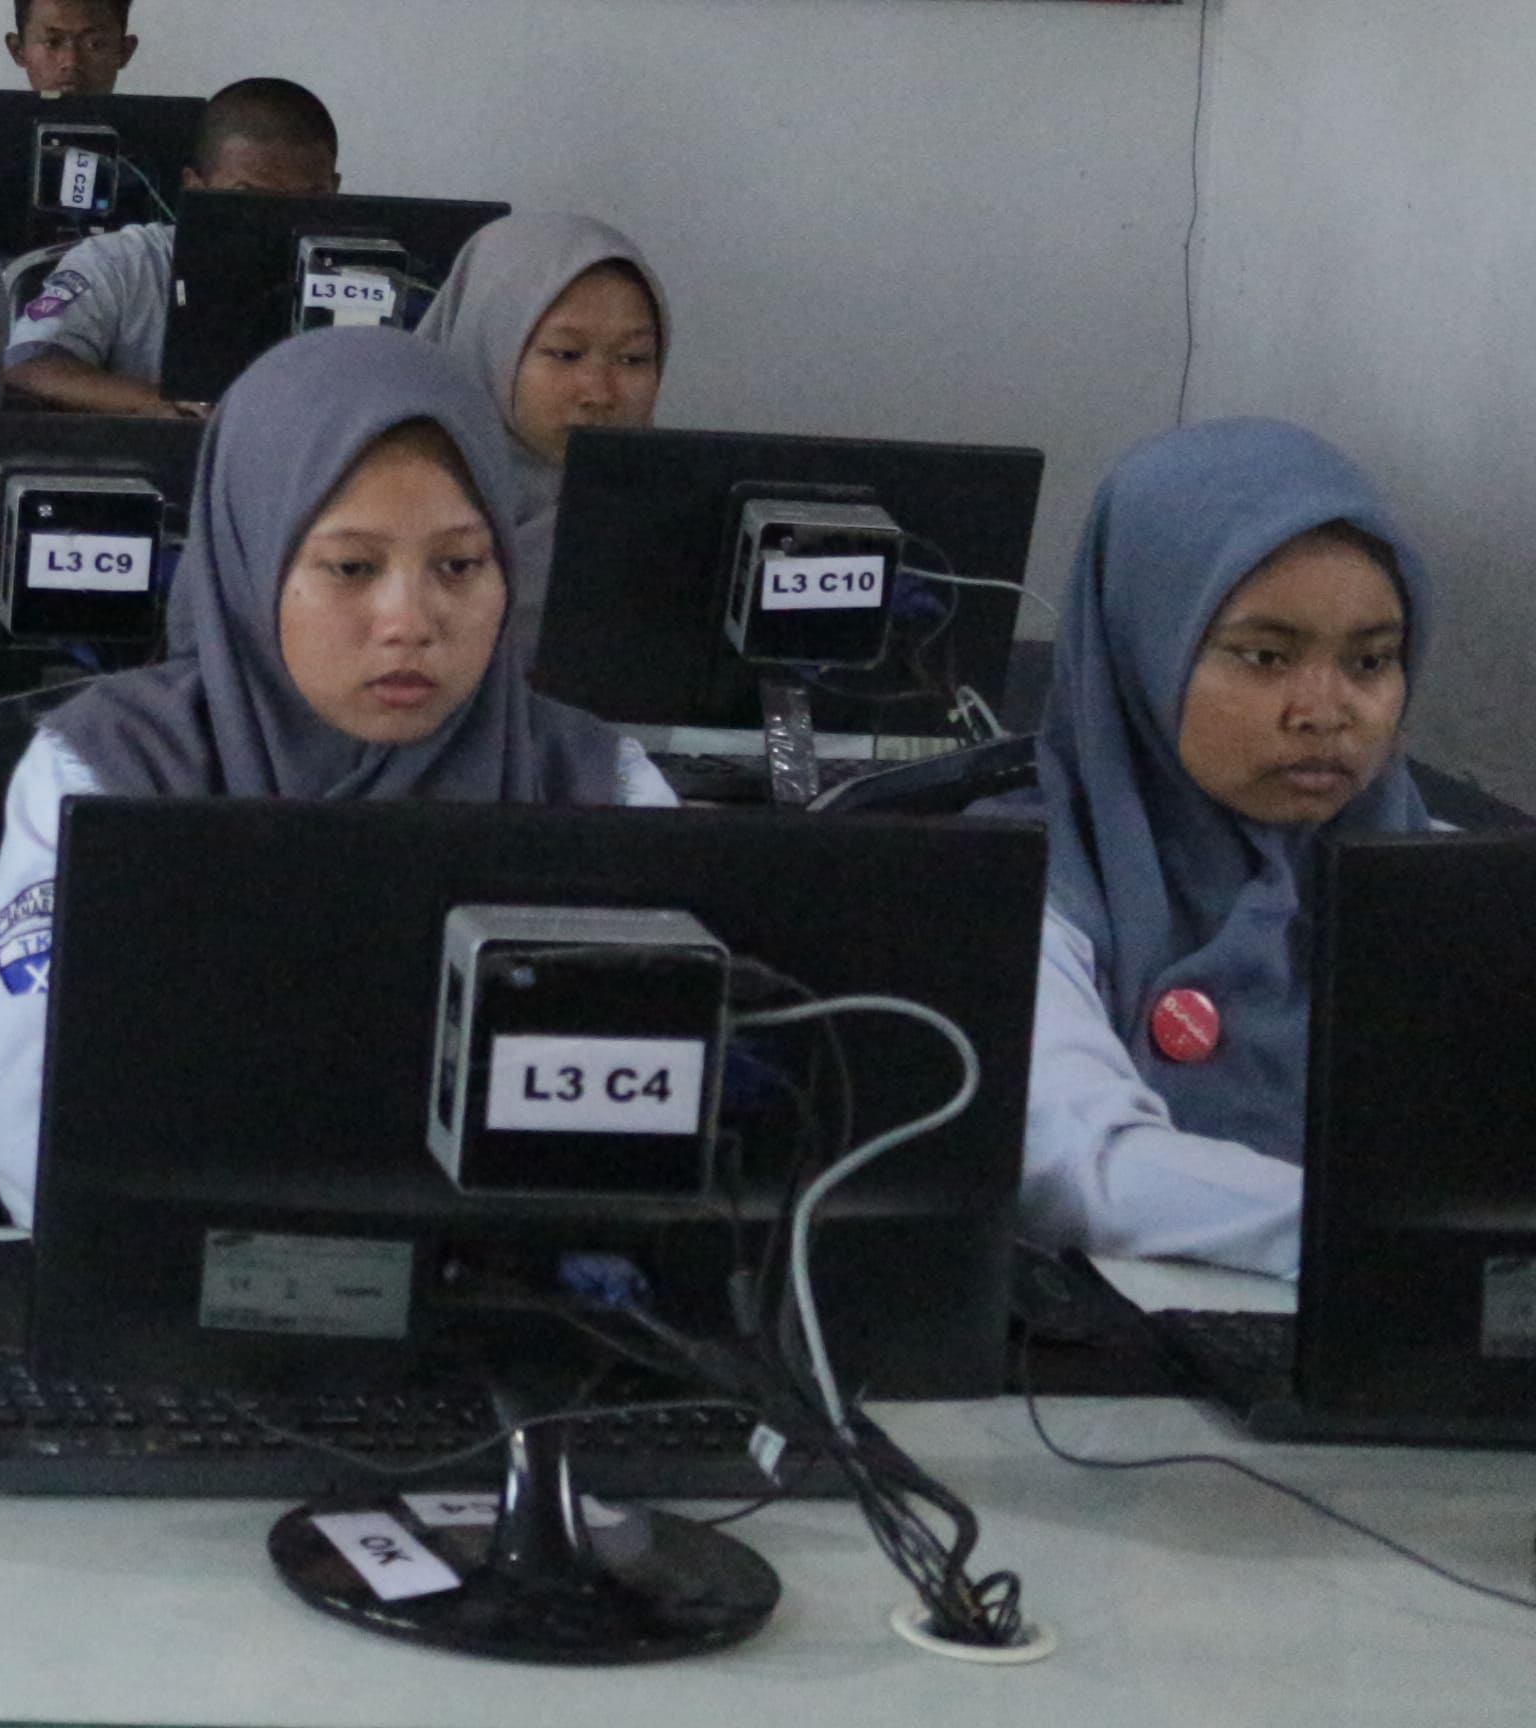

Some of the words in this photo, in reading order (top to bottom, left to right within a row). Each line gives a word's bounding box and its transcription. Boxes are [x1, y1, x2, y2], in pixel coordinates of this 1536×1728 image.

[72, 173, 86, 204] C20
[311, 283, 336, 298] L3
[344, 285, 384, 301] C15
[47, 550, 83, 573] L3
[94, 551, 134, 575] C9
[772, 573, 808, 594] L3
[818, 571, 876, 594] C10
[523, 1065, 585, 1103] L3
[604, 1066, 672, 1104] C4
[359, 1535, 413, 1566] OK
